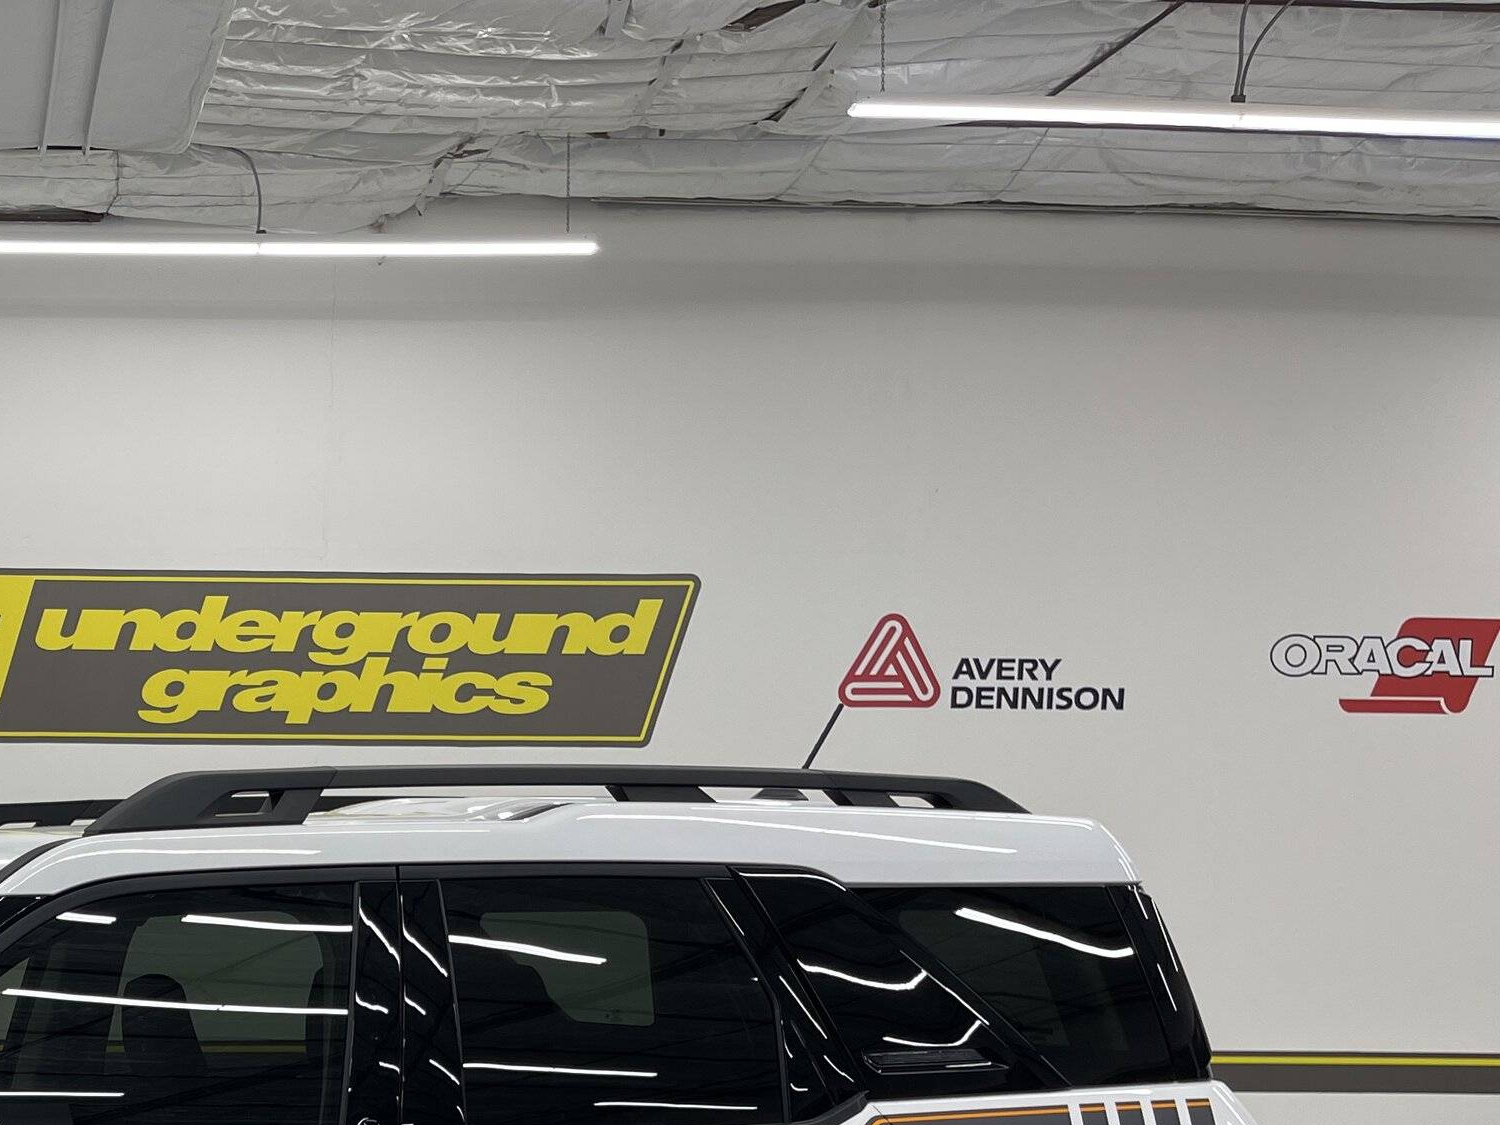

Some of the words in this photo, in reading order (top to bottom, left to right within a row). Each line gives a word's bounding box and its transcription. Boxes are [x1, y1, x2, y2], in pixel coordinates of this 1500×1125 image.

[35, 595, 664, 666] underground
[952, 657, 1062, 681] AVERY
[1270, 633, 1494, 678] ORACAL
[137, 657, 553, 724] graphics
[950, 686, 1125, 711] DENNISON
